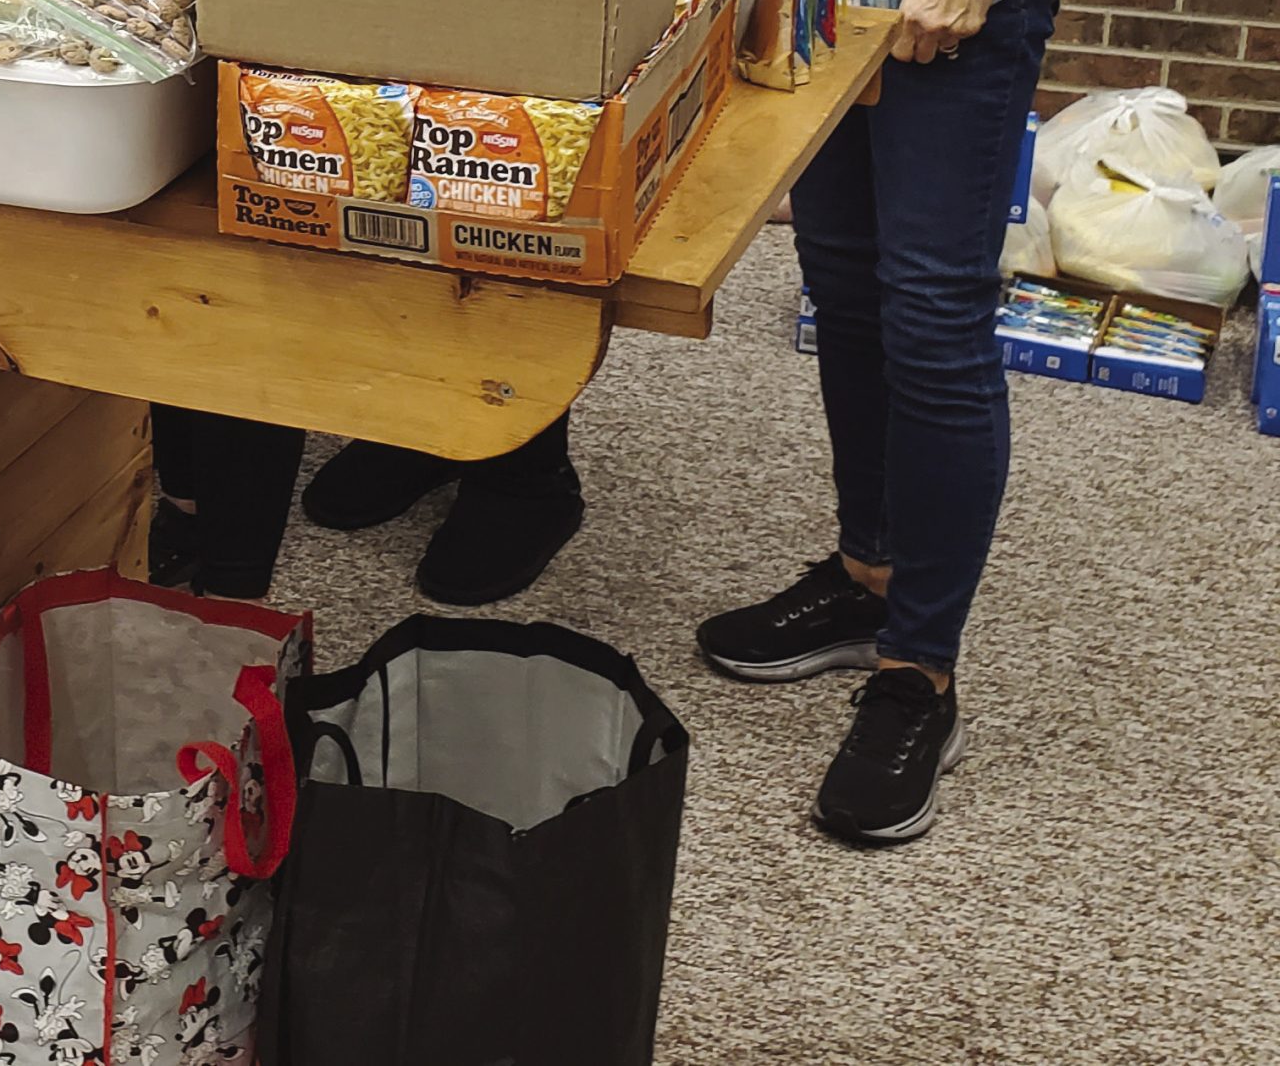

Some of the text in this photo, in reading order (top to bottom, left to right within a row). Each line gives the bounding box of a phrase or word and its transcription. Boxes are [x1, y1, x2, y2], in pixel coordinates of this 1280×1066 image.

[414, 116, 474, 156] Top
[481, 134, 519, 149] NISSIN
[412, 144, 534, 186] Ramen
[232, 184, 281, 215] Top
[437, 179, 523, 207] CHICKEN
[235, 203, 328, 237] Ramen
[454, 224, 582, 259] CHICKEN FLAVOR
